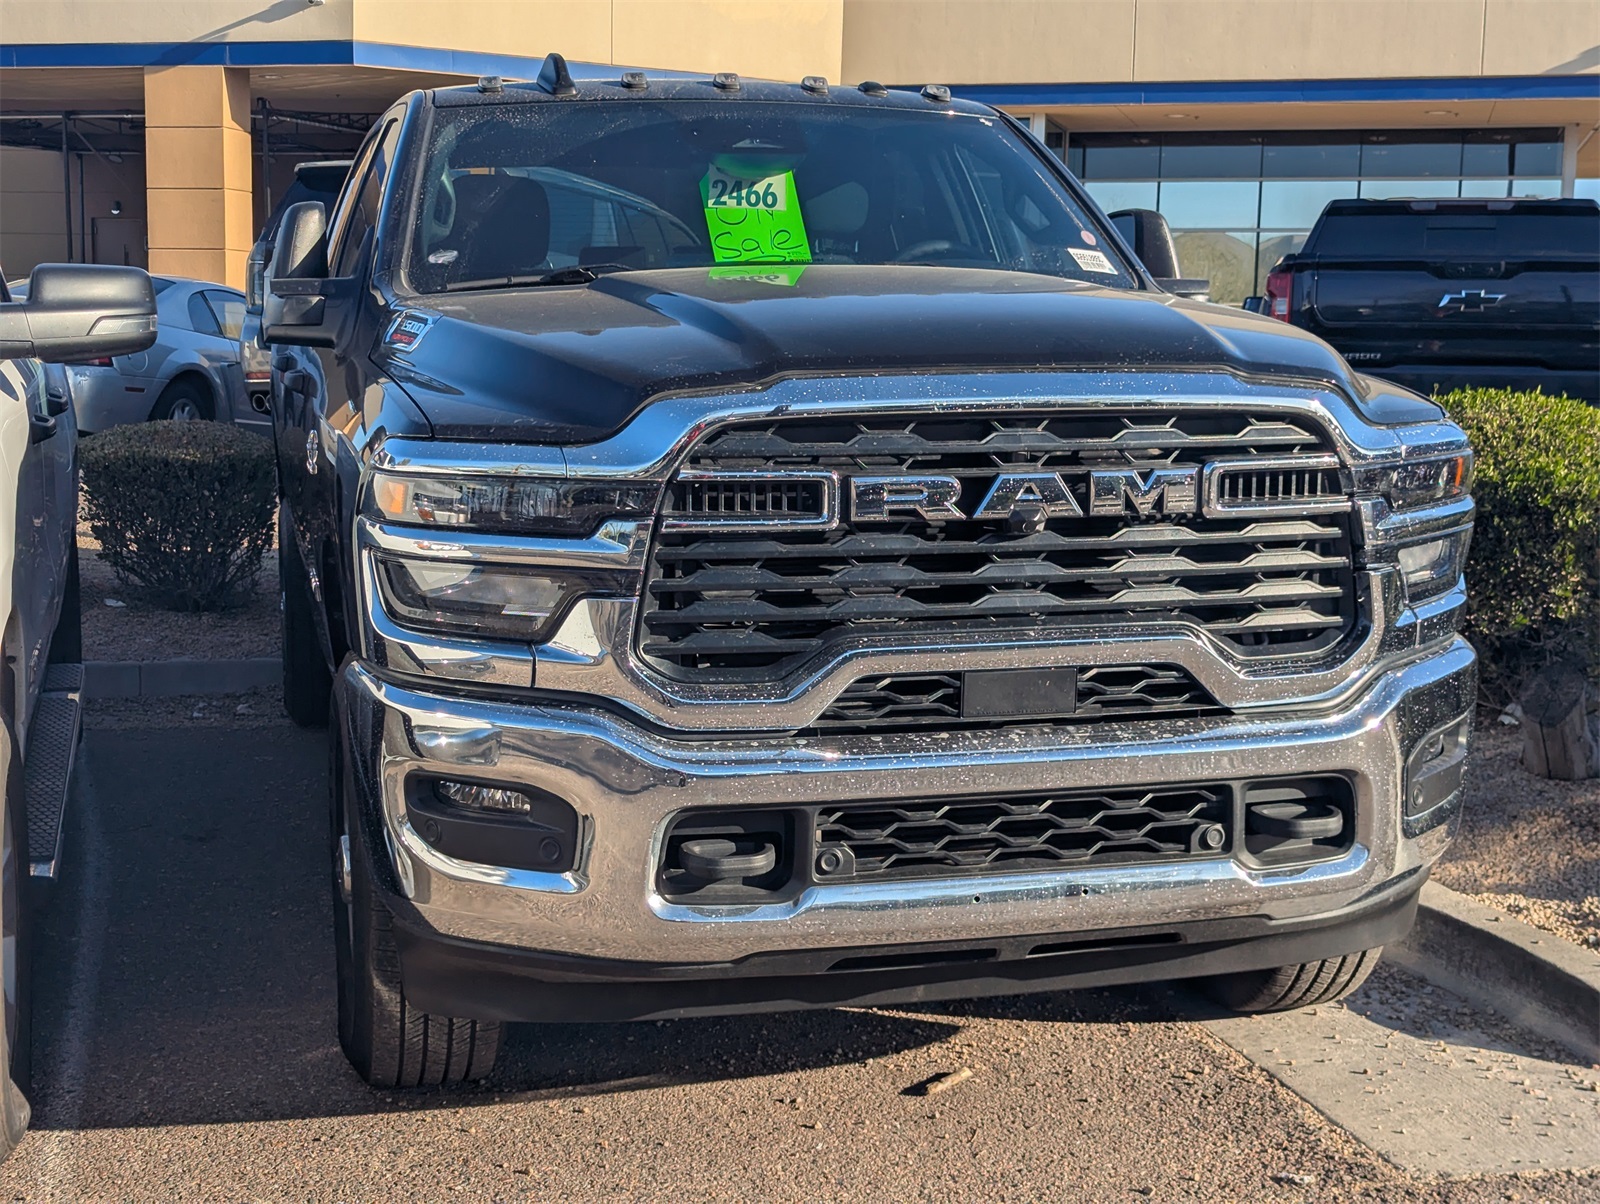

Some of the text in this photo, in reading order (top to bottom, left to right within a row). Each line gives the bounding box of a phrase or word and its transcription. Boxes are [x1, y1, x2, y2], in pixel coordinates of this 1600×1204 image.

[711, 179, 778, 209] 2466
[714, 229, 803, 259] Sale
[850, 467, 1199, 522] RAM
